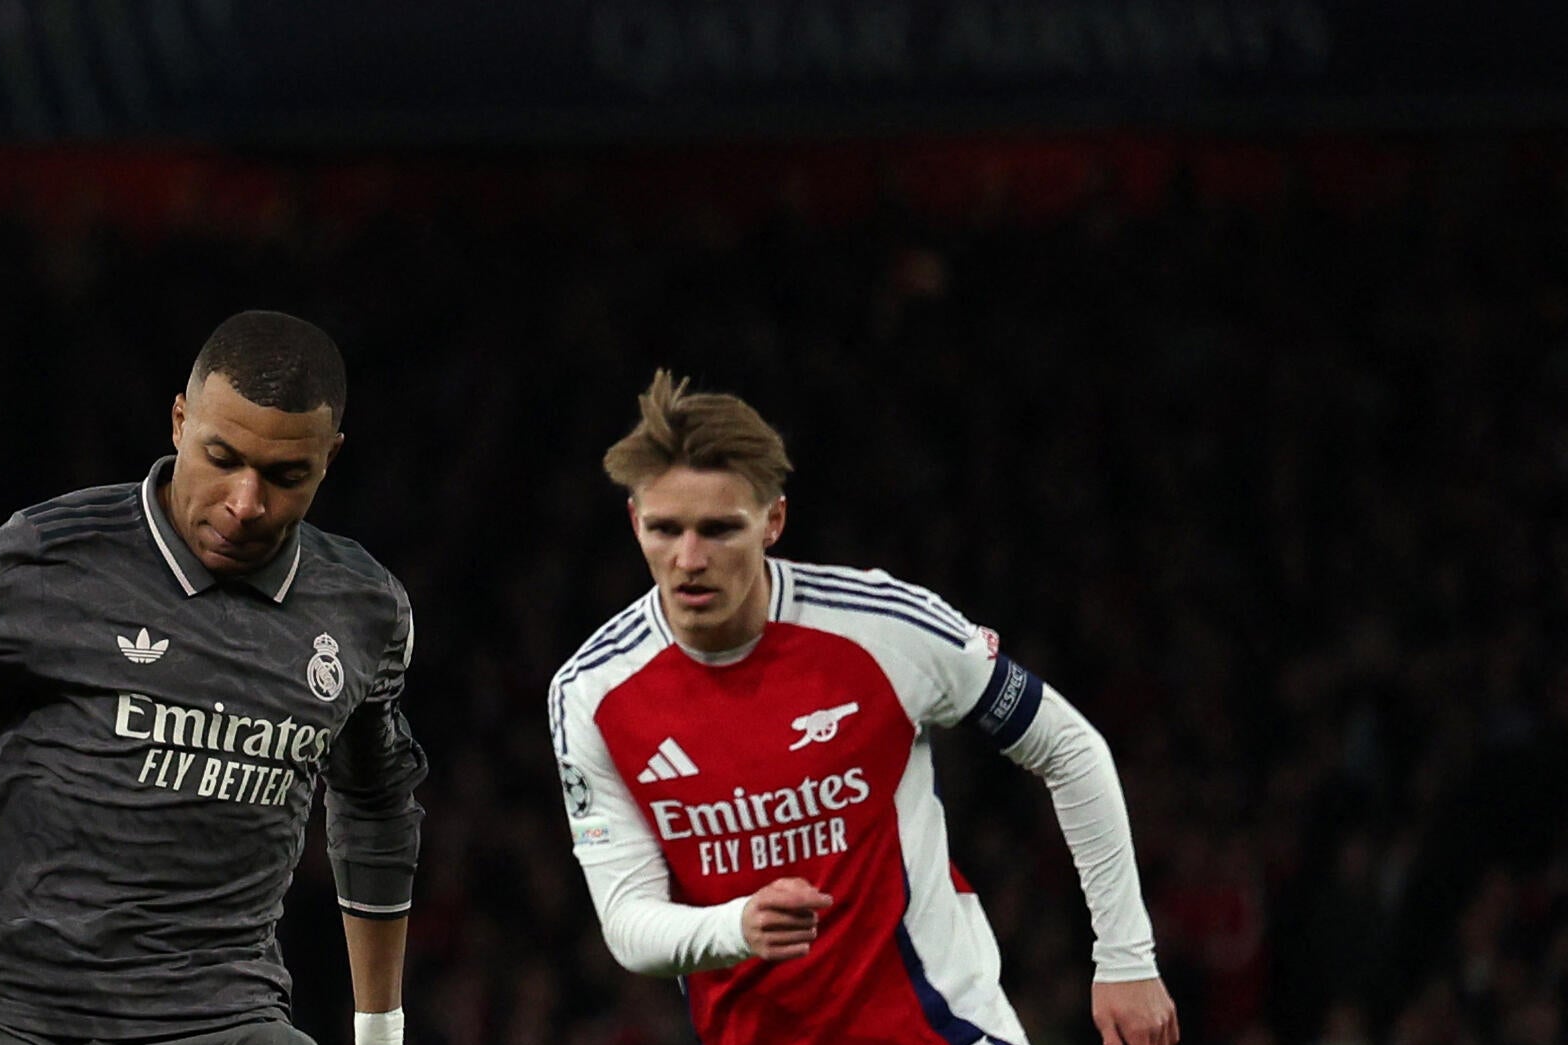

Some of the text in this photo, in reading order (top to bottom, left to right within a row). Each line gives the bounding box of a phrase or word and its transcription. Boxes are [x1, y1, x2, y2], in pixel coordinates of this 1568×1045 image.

[114, 691, 332, 764] Emirates
[137, 748, 295, 807] FLY BETTER
[648, 766, 871, 841] Emirates
[698, 816, 849, 876] FLY BETTER
